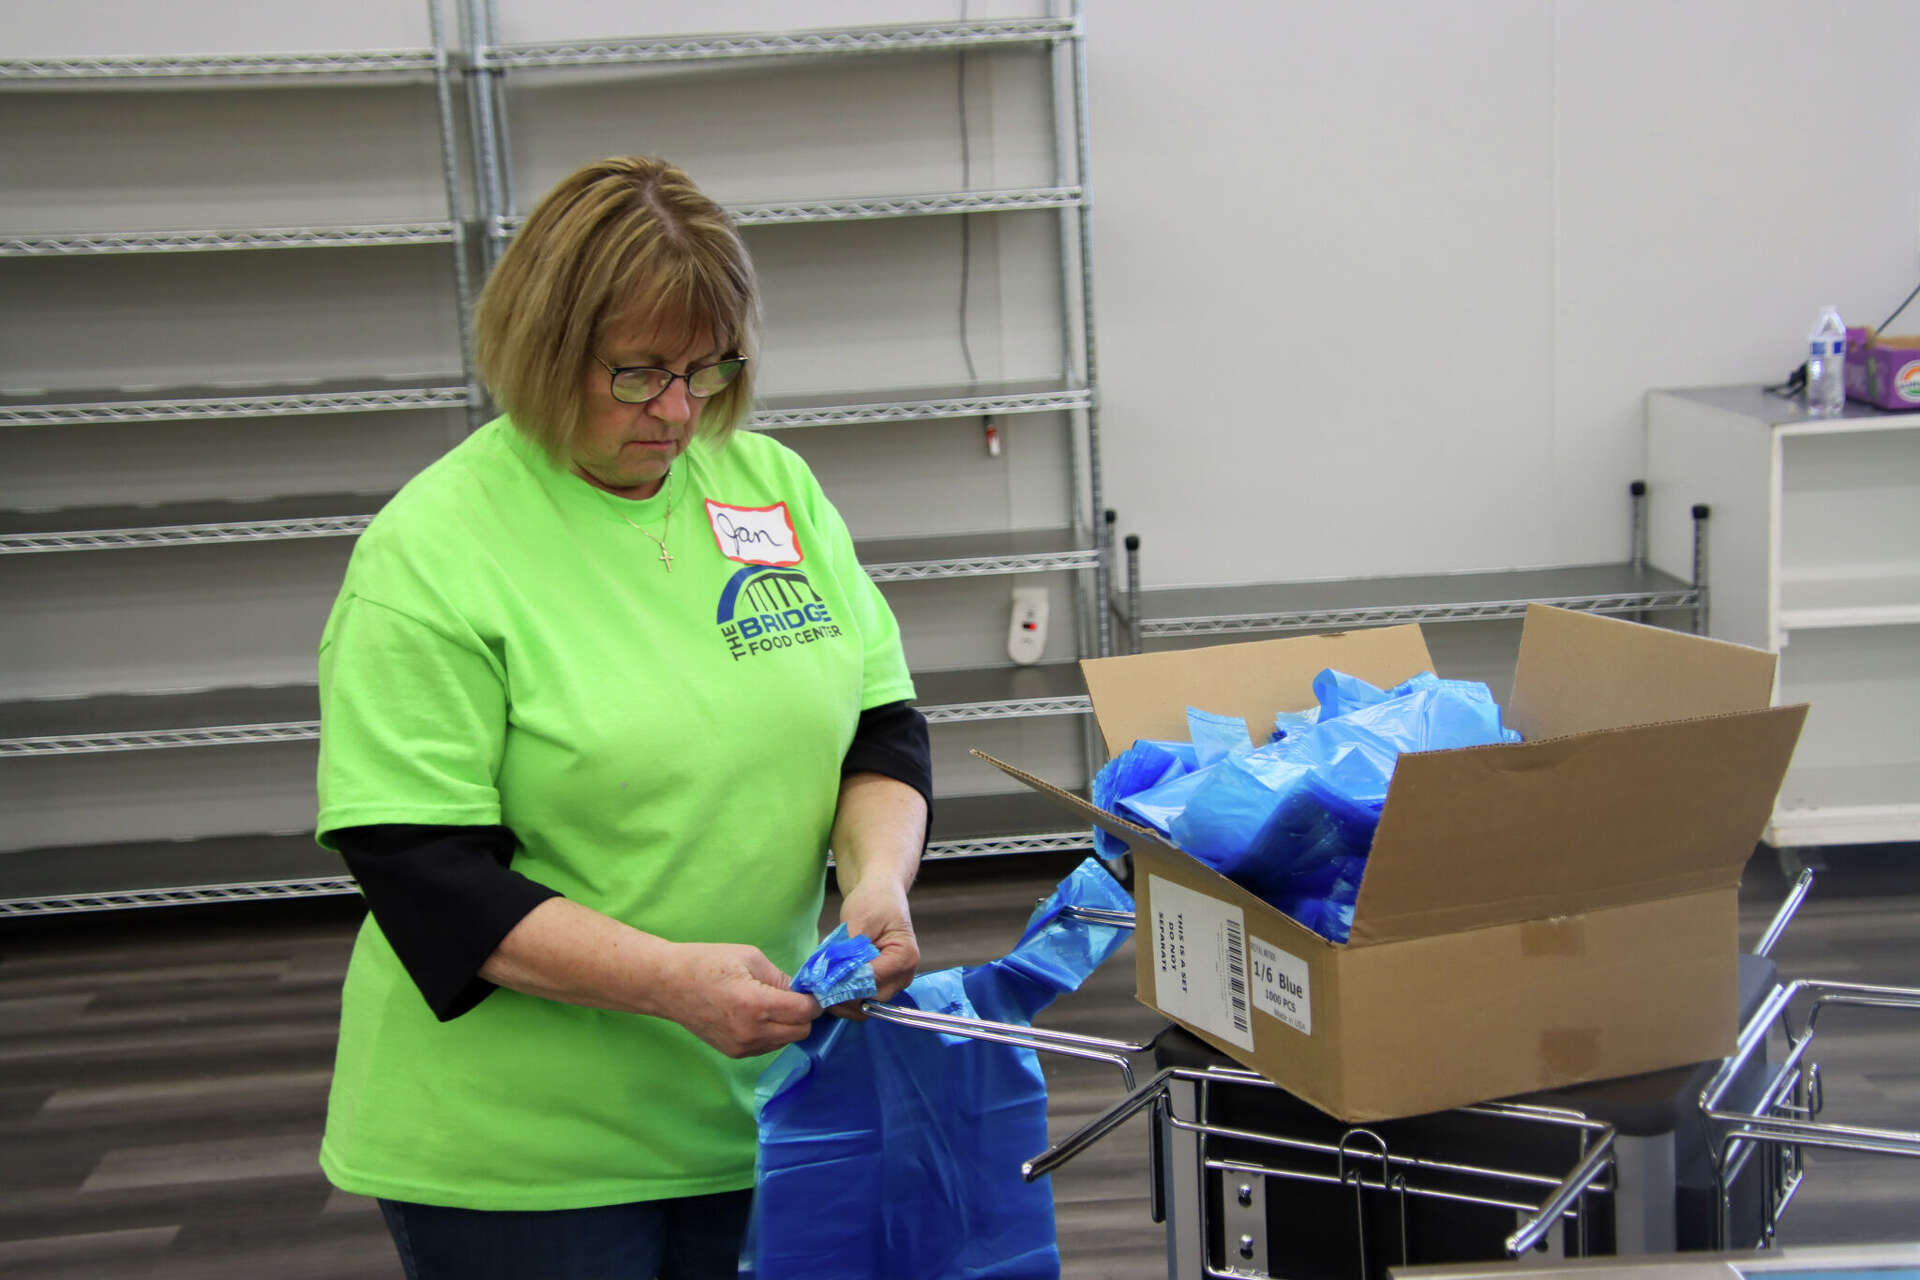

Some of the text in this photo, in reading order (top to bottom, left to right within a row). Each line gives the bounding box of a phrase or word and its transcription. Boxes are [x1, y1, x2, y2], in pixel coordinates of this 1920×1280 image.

[717, 513, 784, 556] Jan
[737, 603, 833, 640] BRIDGE
[720, 624, 747, 661] THE
[748, 624, 843, 655] FOOD CENTER
[1158, 912, 1167, 971] SEPARATE
[1168, 922, 1175, 940] DO
[1177, 913, 1185, 942] THIS
[1179, 945, 1186, 956] IS
[1254, 961, 1303, 1000] 1/6 Blue
[1265, 988, 1296, 1013] 1000 PCS
